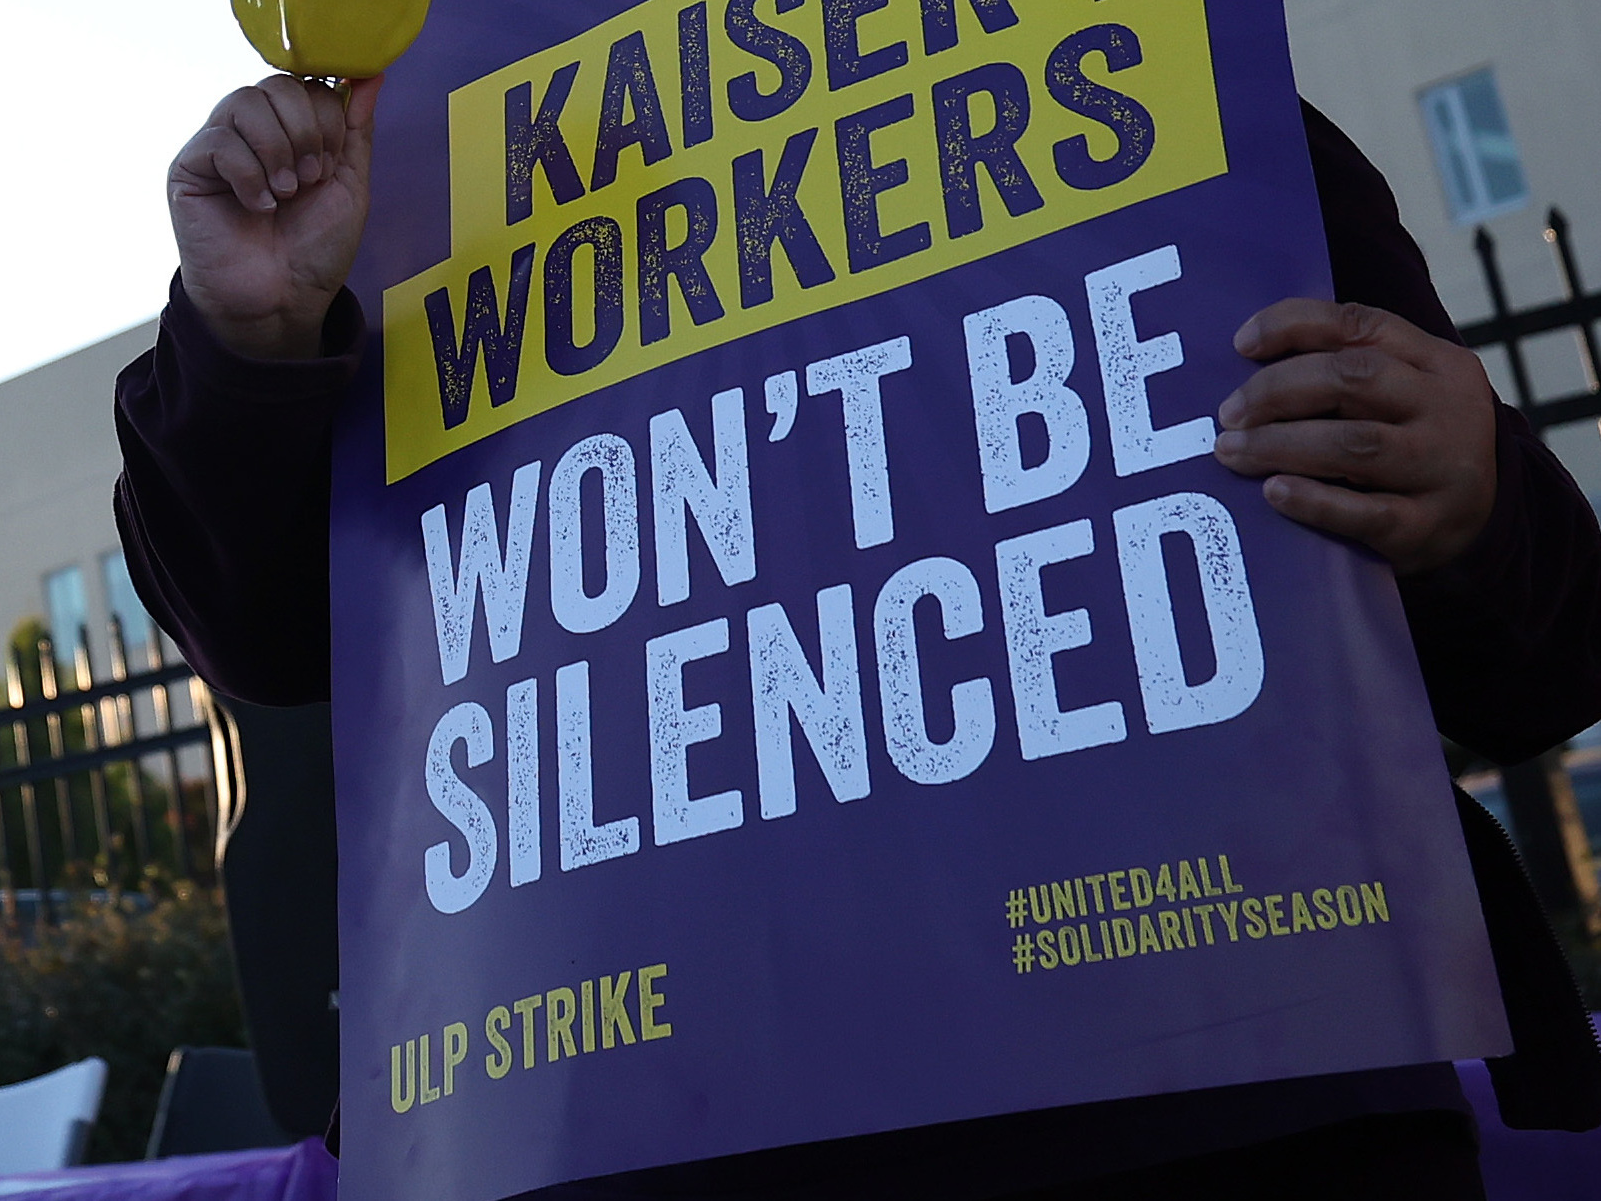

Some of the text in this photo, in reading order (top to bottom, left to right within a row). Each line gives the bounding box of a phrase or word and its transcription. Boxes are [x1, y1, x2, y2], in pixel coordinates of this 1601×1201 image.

[423, 22, 1156, 430] WORKERS
[421, 243, 1216, 686] WON'T BE
[423, 491, 1266, 915] SILENCED
[1005, 854, 1244, 929] #UNITED4ALL
[1011, 881, 1390, 975] #SOLIDARITYSEASON
[391, 963, 672, 1114] ULP STRIKE
